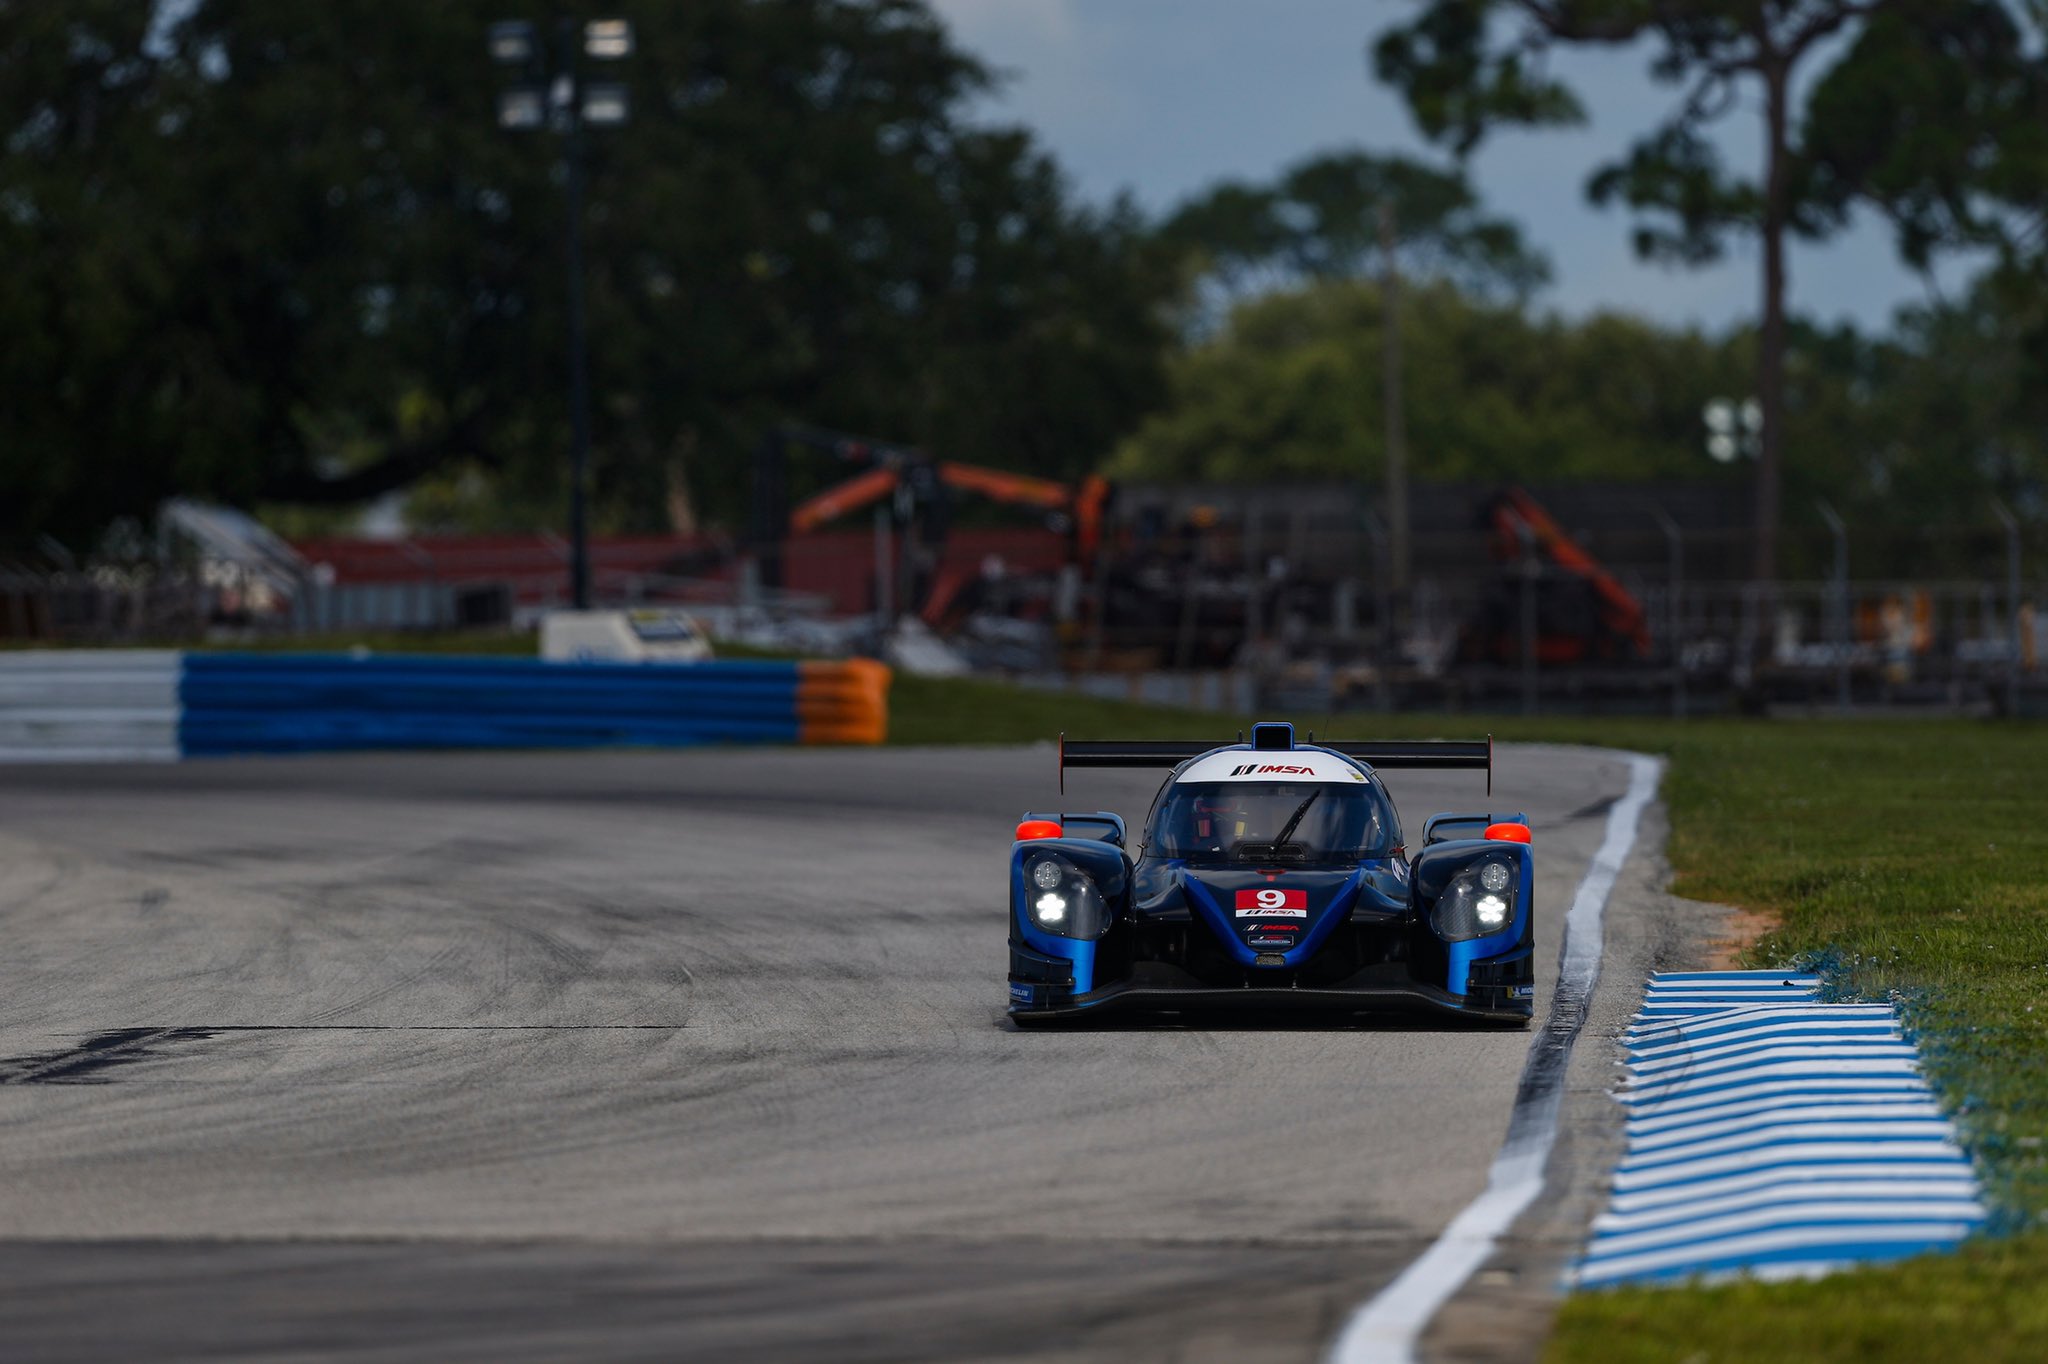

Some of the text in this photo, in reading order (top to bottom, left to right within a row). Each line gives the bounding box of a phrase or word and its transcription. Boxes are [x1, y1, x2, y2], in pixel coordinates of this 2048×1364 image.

[1257, 765, 1315, 776] IMSA
[1256, 889, 1286, 909] 9
[1260, 924, 1299, 932] IMSA
